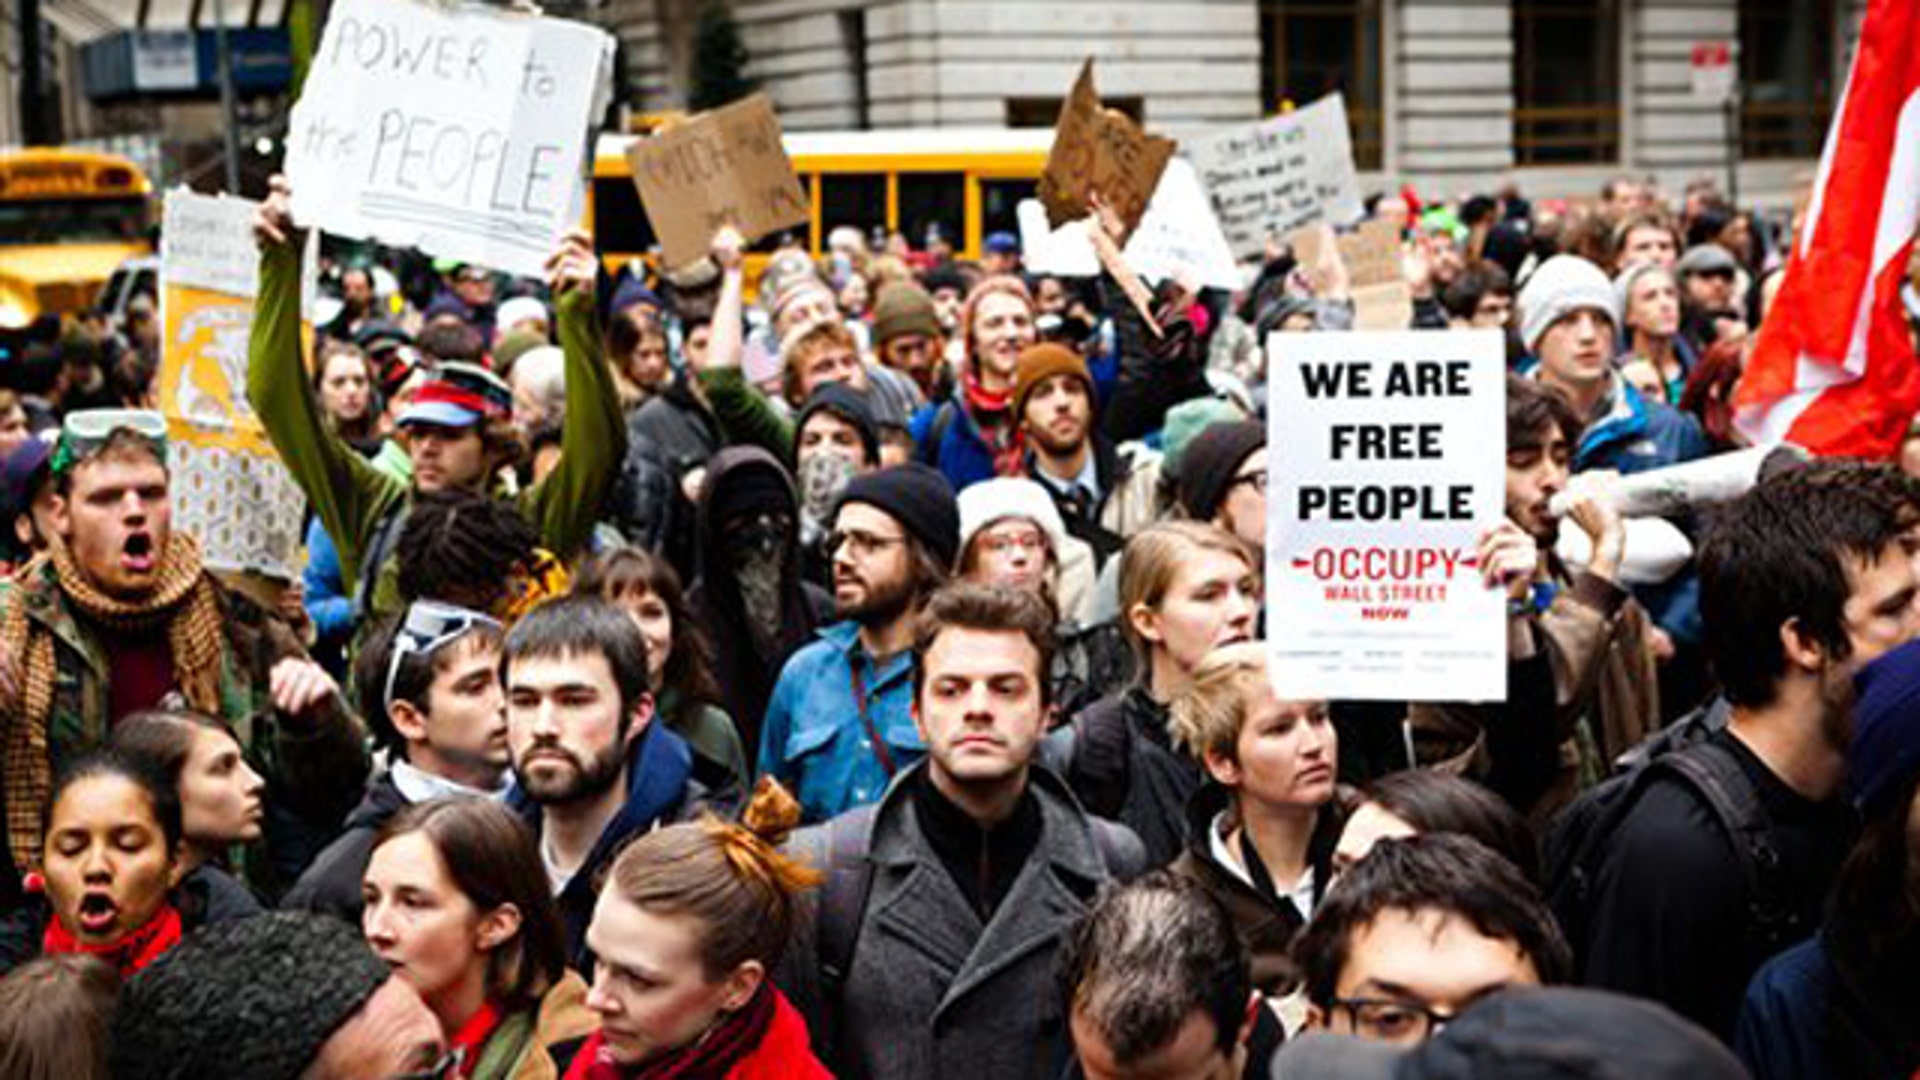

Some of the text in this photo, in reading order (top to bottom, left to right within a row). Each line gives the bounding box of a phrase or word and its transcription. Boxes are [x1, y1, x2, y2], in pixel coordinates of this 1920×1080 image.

[331, 16, 556, 97] POWER to
[368, 107, 562, 216] PEOPLE
[1299, 361, 1471, 399] WE ARE
[1331, 423, 1443, 460] FREE
[1298, 485, 1474, 521] PEOPLE
[1312, 547, 1461, 581] OCCUPY
[1324, 584, 1447, 601] WALL STREET
[1361, 607, 1409, 621] NOW
